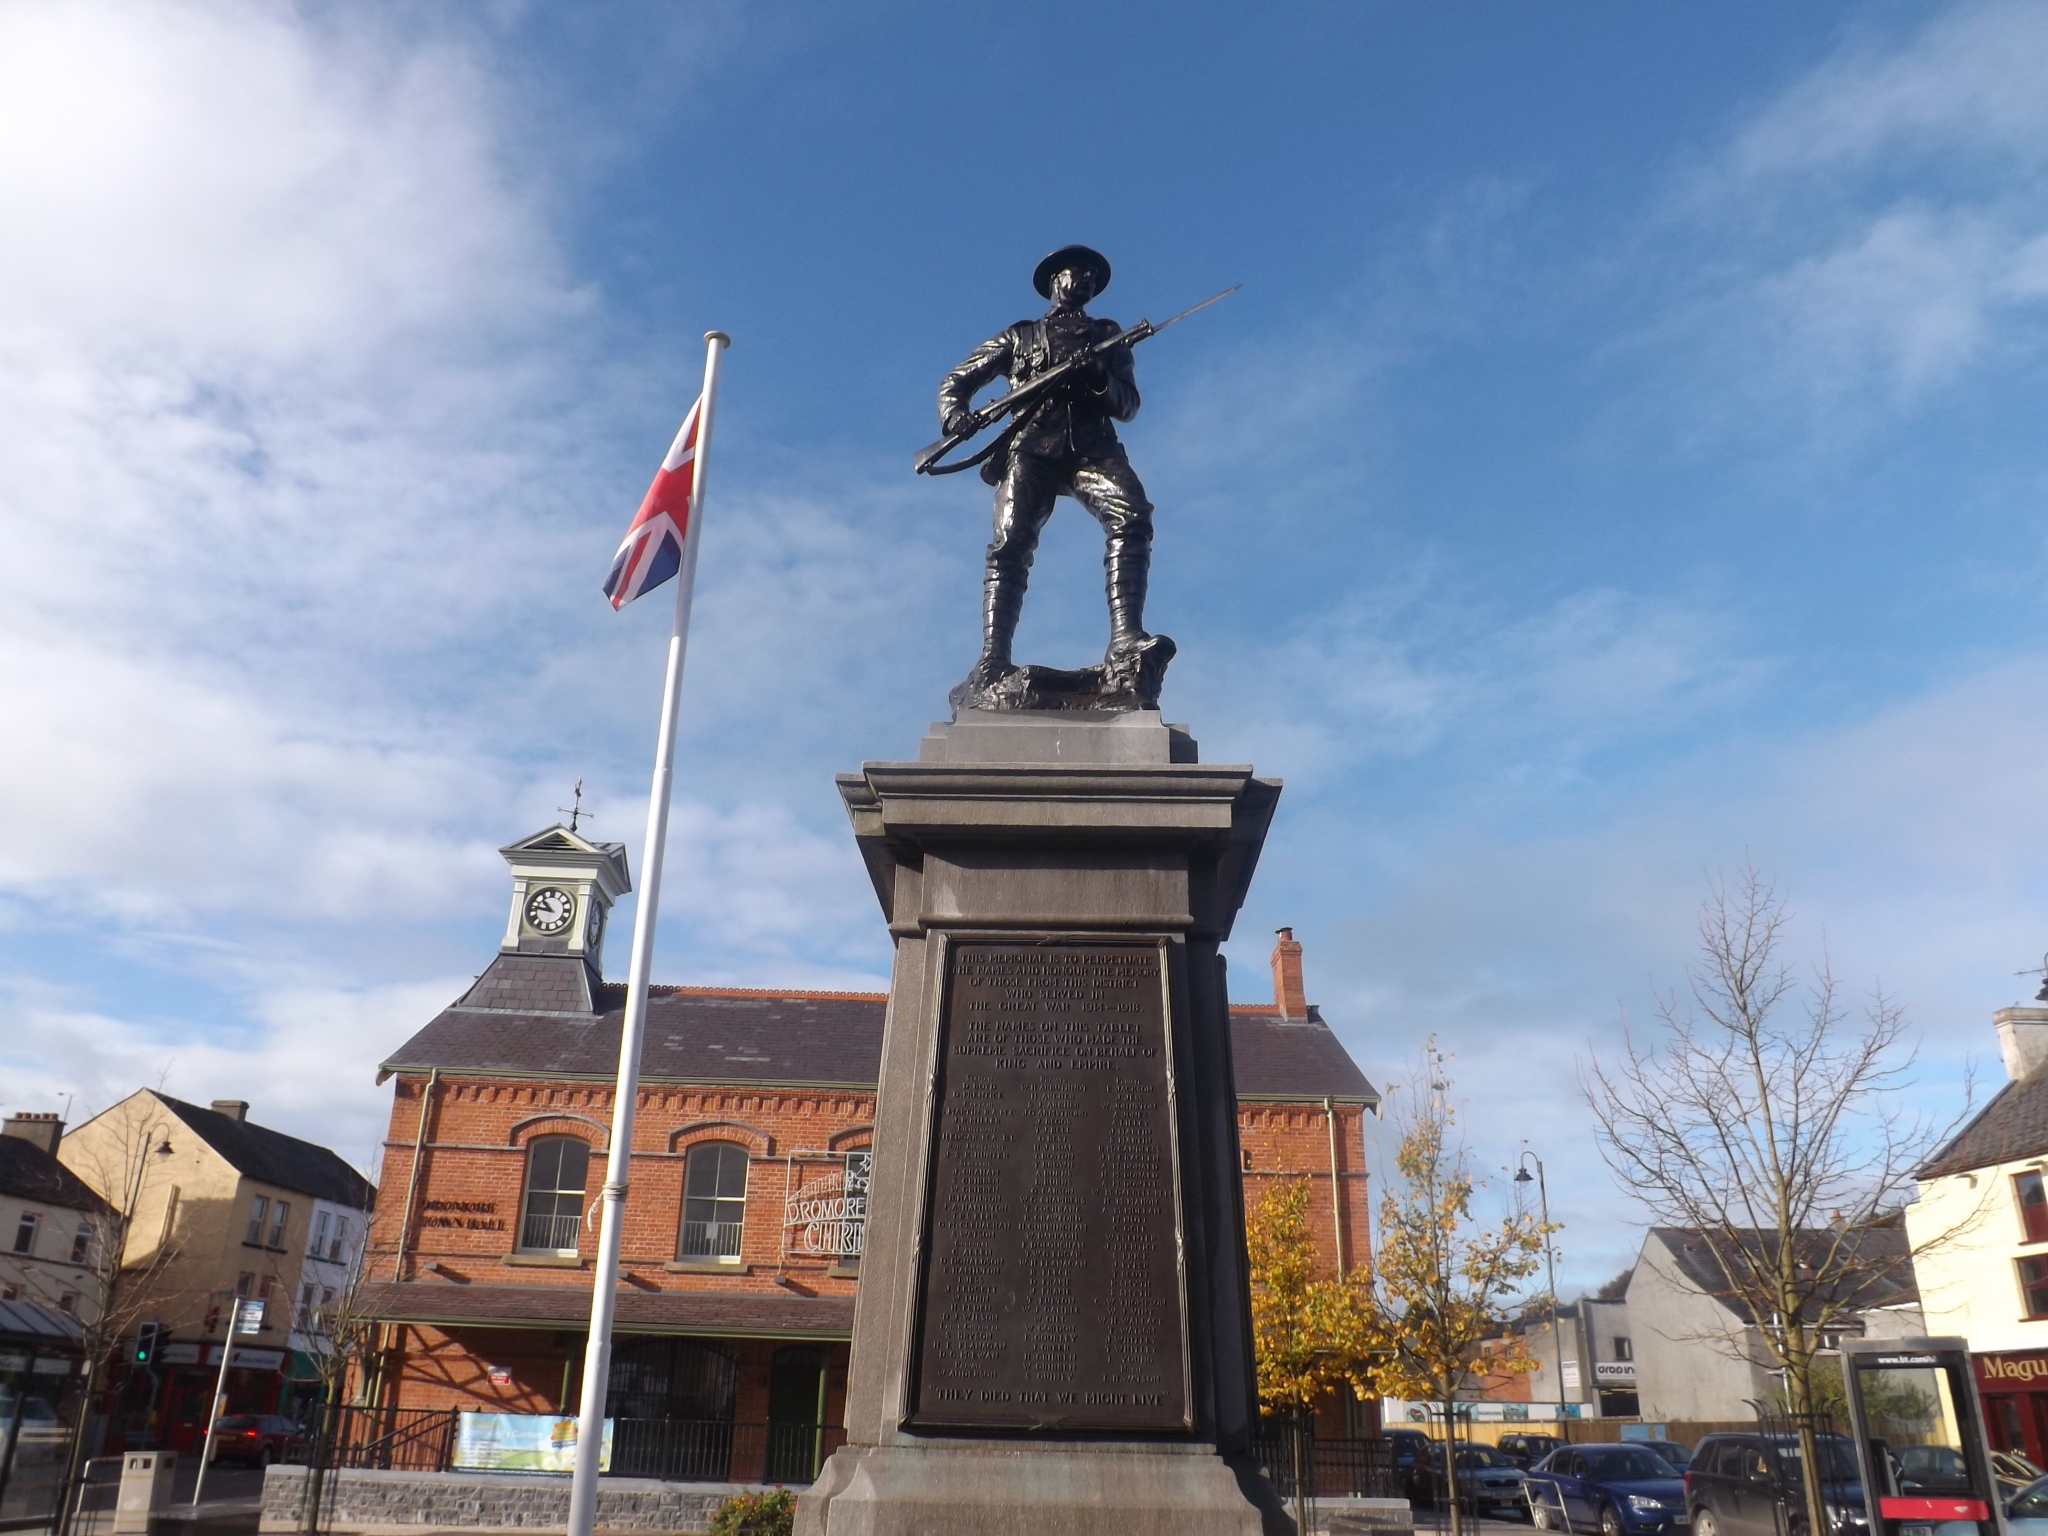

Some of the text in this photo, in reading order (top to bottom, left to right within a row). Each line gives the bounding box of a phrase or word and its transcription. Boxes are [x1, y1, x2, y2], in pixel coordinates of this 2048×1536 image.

[960, 954, 1153, 965] THIS MEMORIAL IS TO PERPETUATE
[952, 966, 1161, 978] THE NAMES AND HONOUR THE MEMORY
[968, 978, 1140, 989] OF THOSE FROM THIS DISTRICT
[1005, 990, 1105, 1000] WHO SERVED IN
[967, 1001, 992, 1011] THE
[998, 1002, 1039, 1011] GREAT
[1044, 1002, 1071, 1012] WAR
[967, 1021, 1143, 1033] THE NAMES ON THIS TABLET
[966, 1034, 1144, 1045] ARE OF THOSE WHO MADE THE
[952, 1046, 1159, 1058] SUPREME SACRIFICE ON BEHALF OF
[995, 1059, 1121, 1070] KING AND EMPIRE.
[424, 1200, 498, 1214] DROMORE
[787, 1197, 866, 1223] DROMORE
[422, 1216, 508, 1232] TOWN HALL
[1598, 1366, 1623, 1374] drop
[979, 1390, 1012, 1402] DIED
[1017, 1391, 1051, 1403] THAT
[1057, 1391, 1080, 1404] WE
[1085, 1392, 1130, 1405] MIGHT
[463, 1429, 510, 1439] Community
[512, 1430, 543, 1438] Garden
